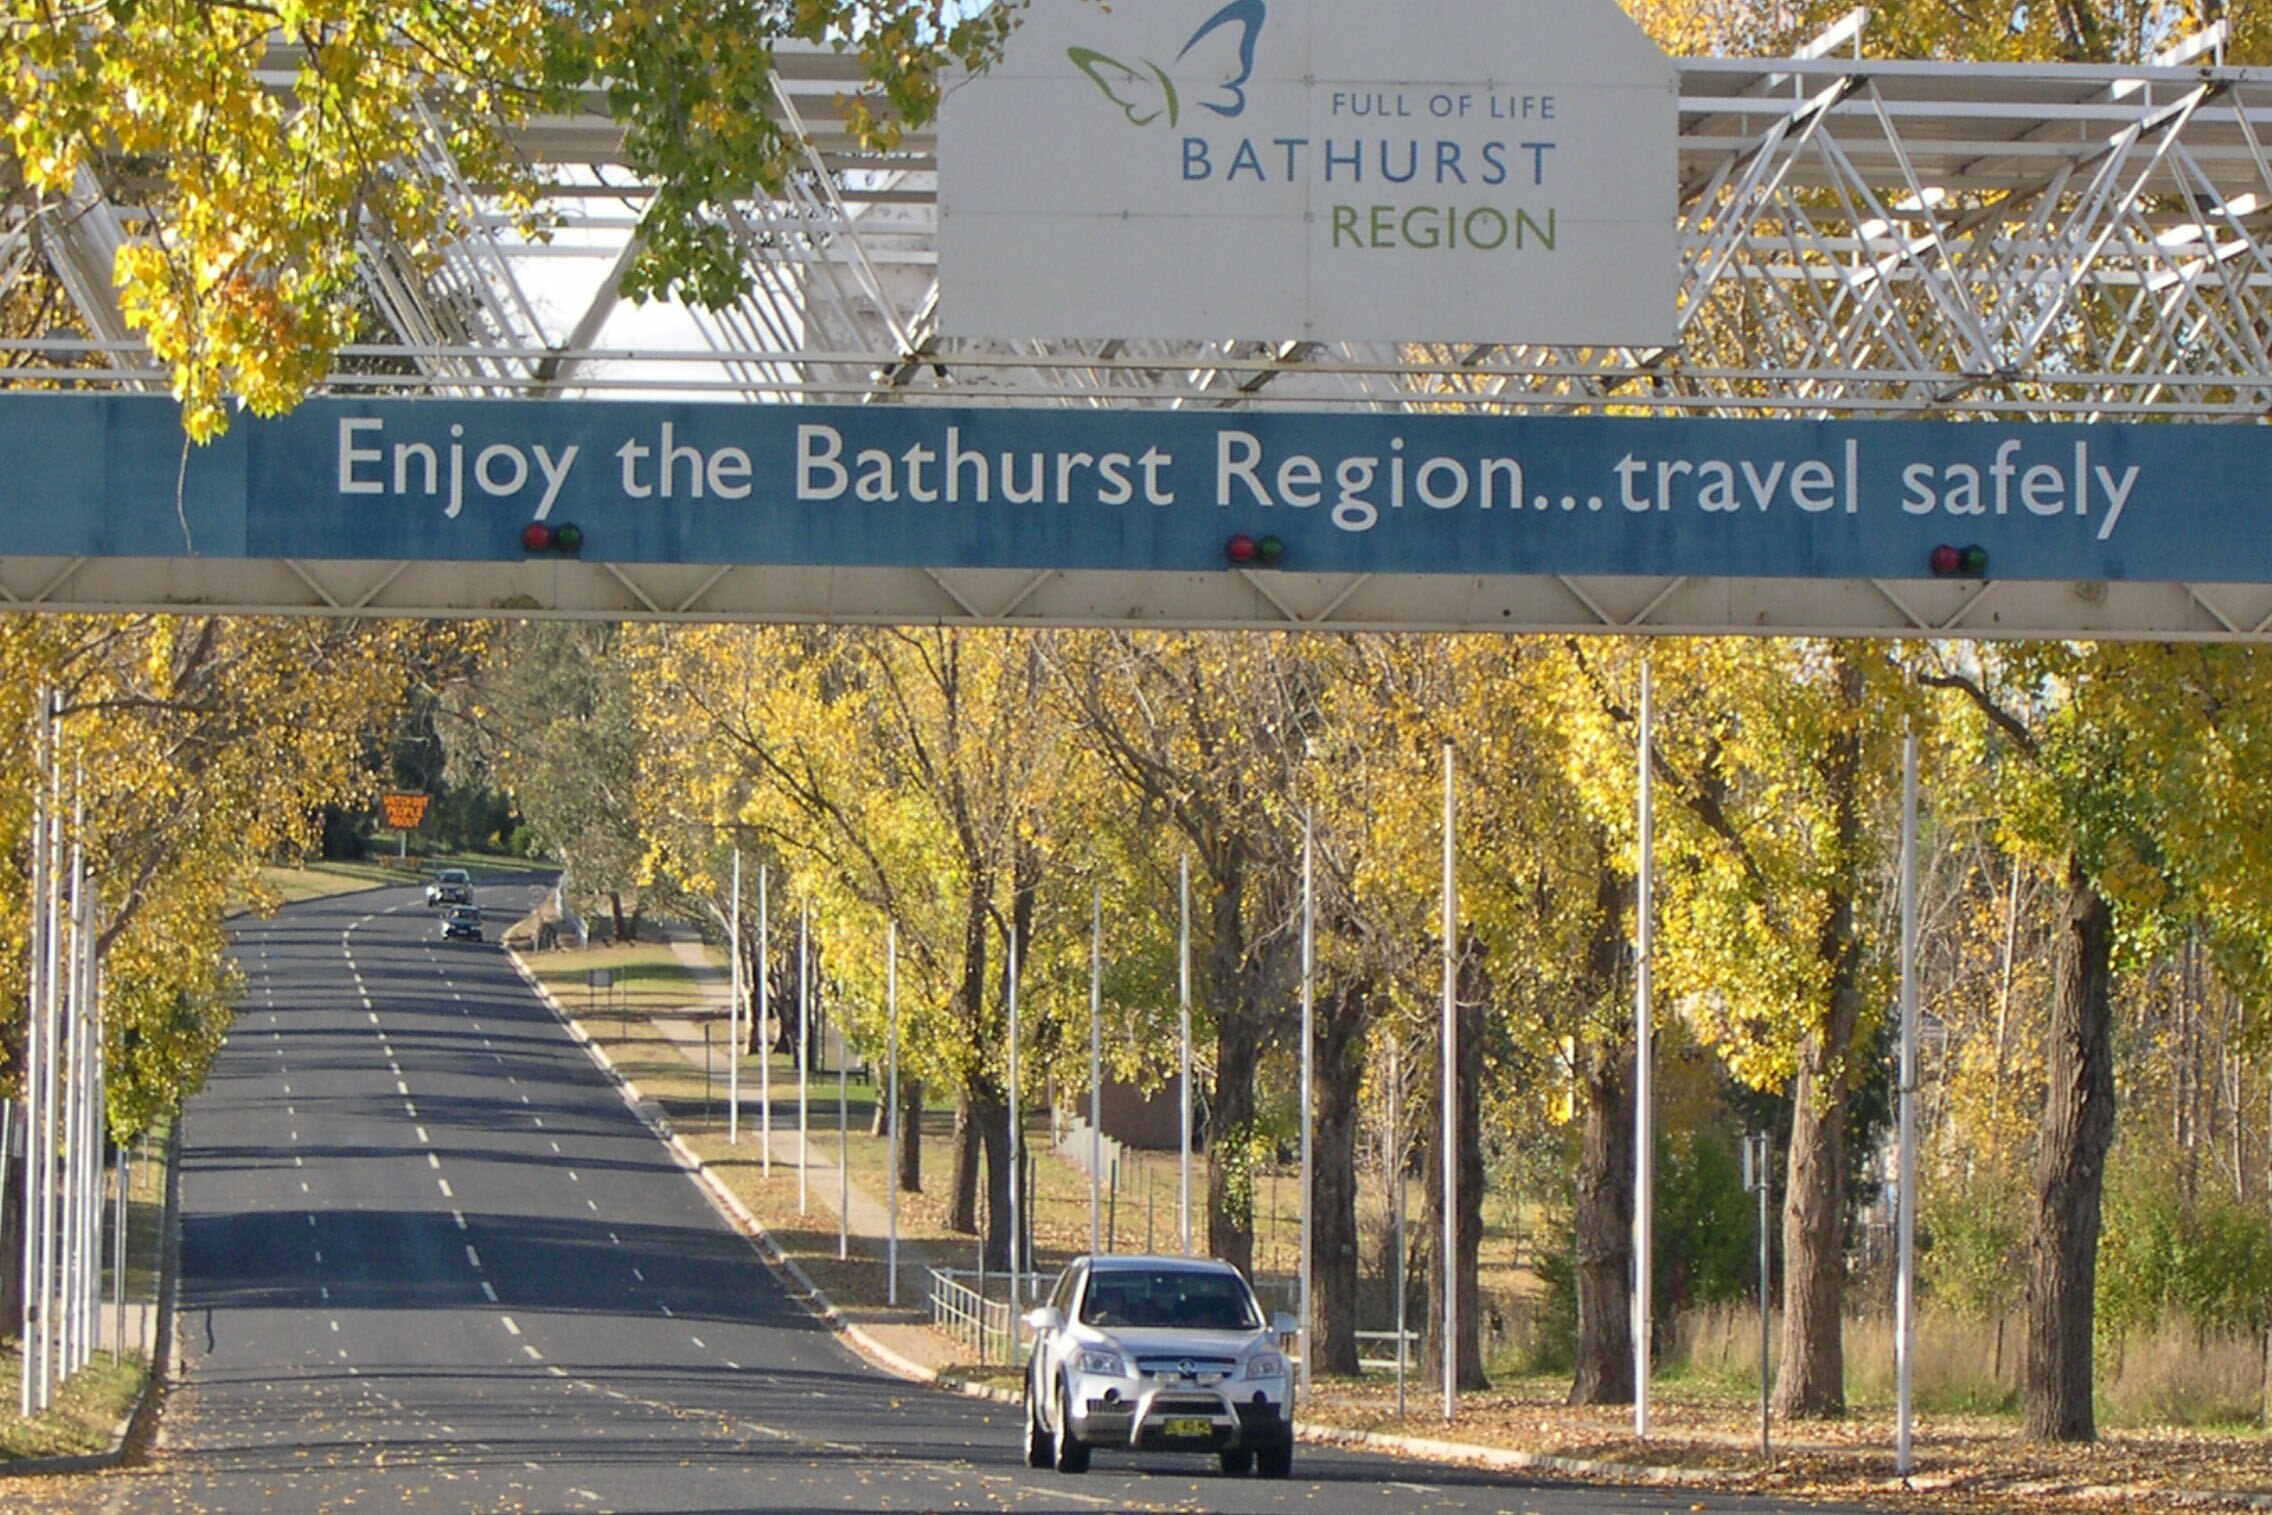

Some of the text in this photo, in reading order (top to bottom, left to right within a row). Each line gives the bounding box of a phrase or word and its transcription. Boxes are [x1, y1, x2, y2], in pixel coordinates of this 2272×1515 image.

[1332, 92, 1556, 120] FULL OF LIFE
[1182, 137, 1556, 186] BATHURST
[1332, 205, 1556, 251] REGION
[336, 417, 578, 520] Enjoy
[616, 422, 752, 500] the
[797, 425, 1174, 505] Bathurst
[1901, 440, 2140, 539] safely
